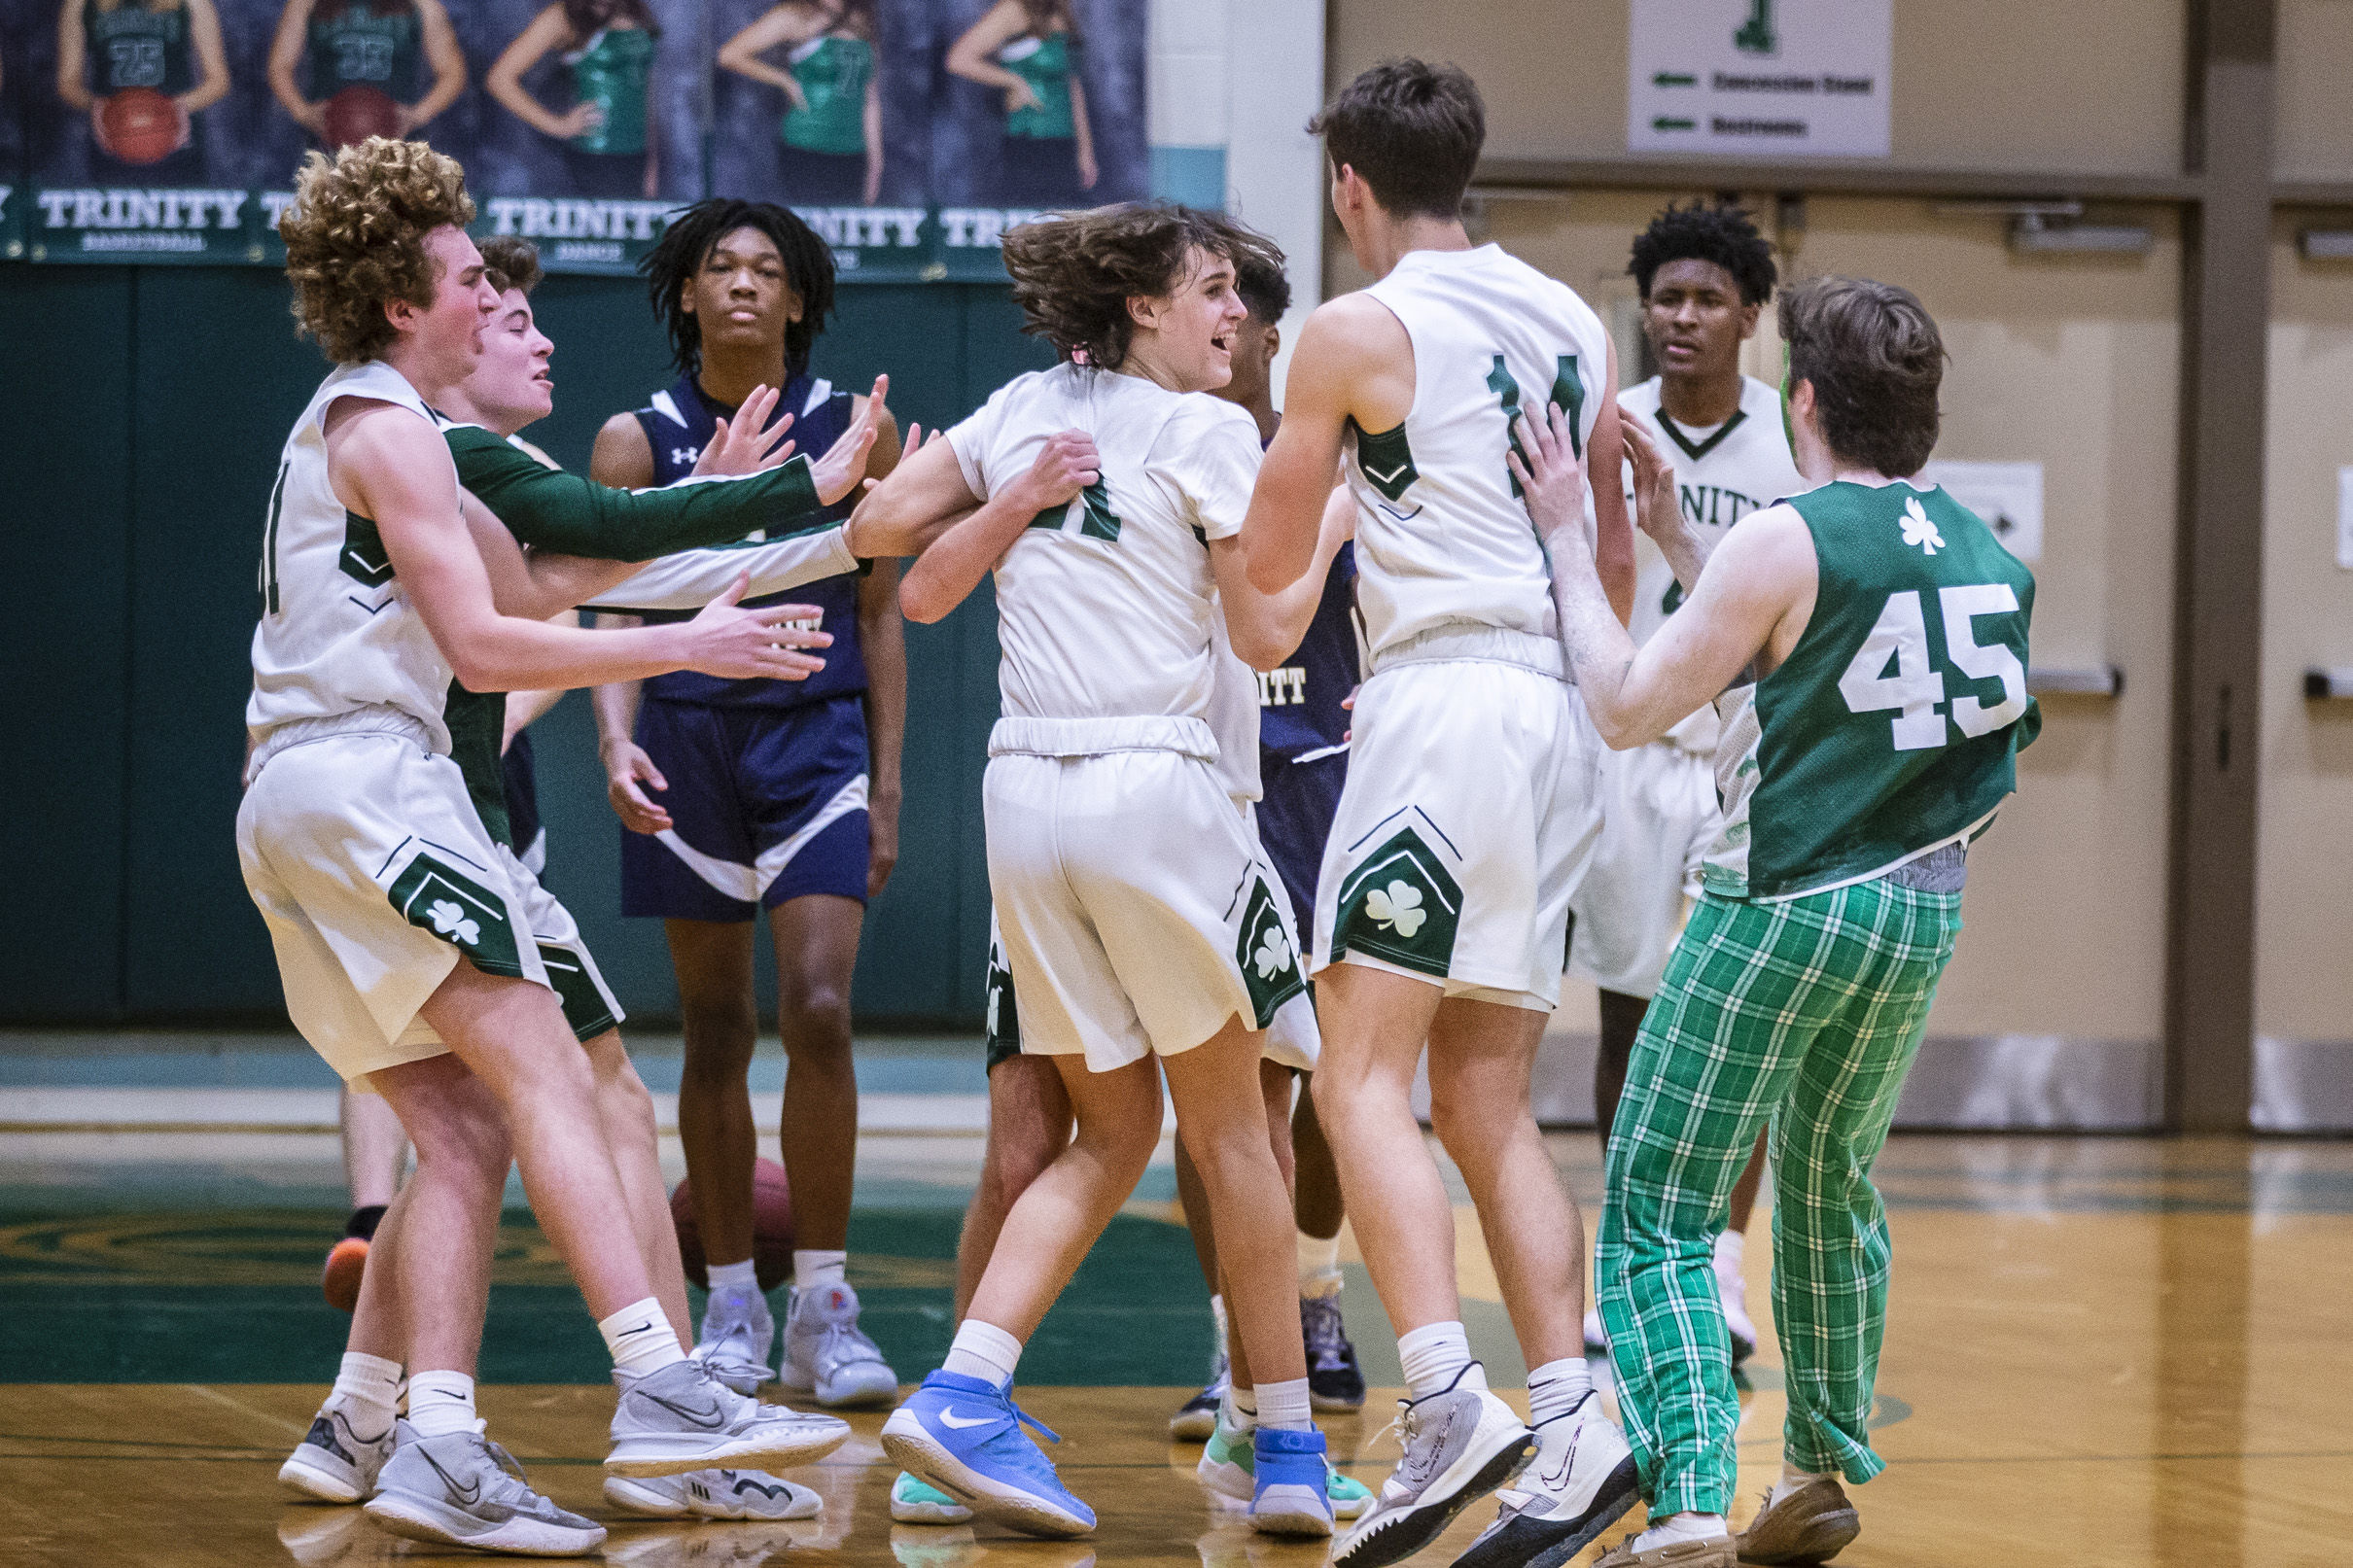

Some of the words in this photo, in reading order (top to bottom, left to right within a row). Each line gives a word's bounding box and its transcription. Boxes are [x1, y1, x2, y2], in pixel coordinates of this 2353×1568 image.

[37, 189, 248, 229] TRINITY
[1257, 667, 1307, 707] ITT
[1839, 583, 2027, 751] 45
